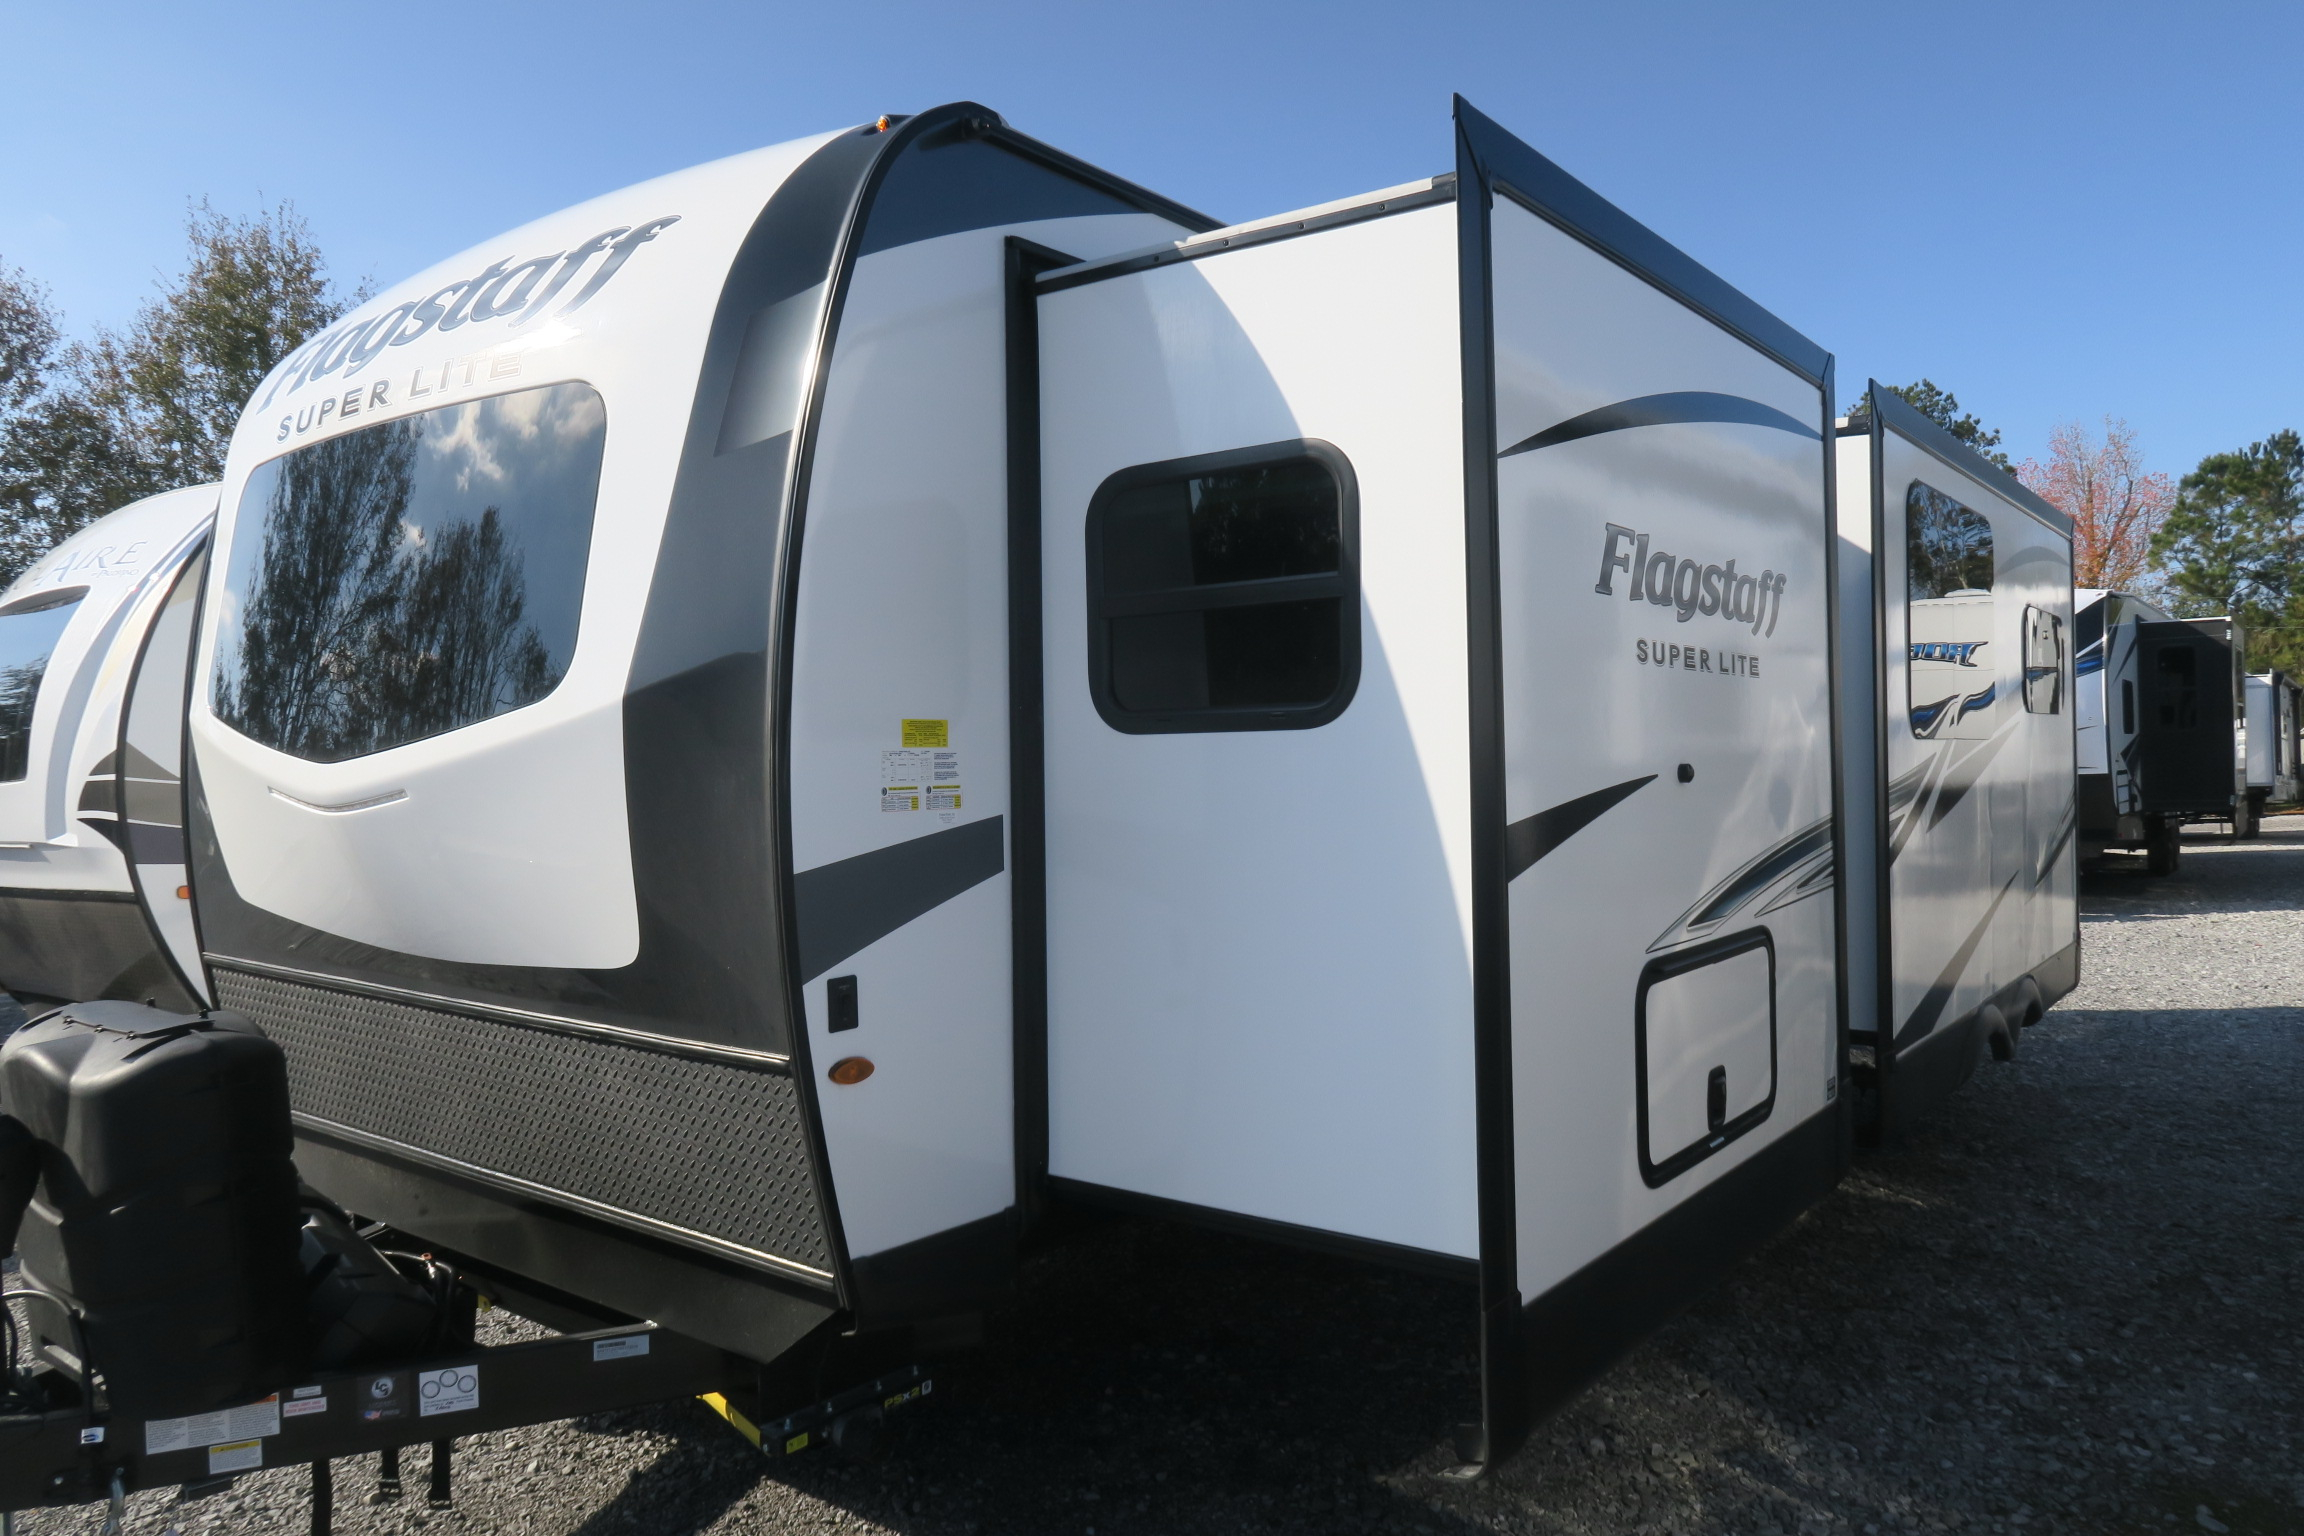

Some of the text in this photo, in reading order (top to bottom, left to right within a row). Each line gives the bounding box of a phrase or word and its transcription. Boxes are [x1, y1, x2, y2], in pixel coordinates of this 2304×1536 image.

[256, 214, 683, 415] Flagstaff
[276, 352, 524, 444] SUPER LITE
[1594, 522, 1788, 639] Flagstaff
[1635, 637, 1761, 678] SUPER LITE
